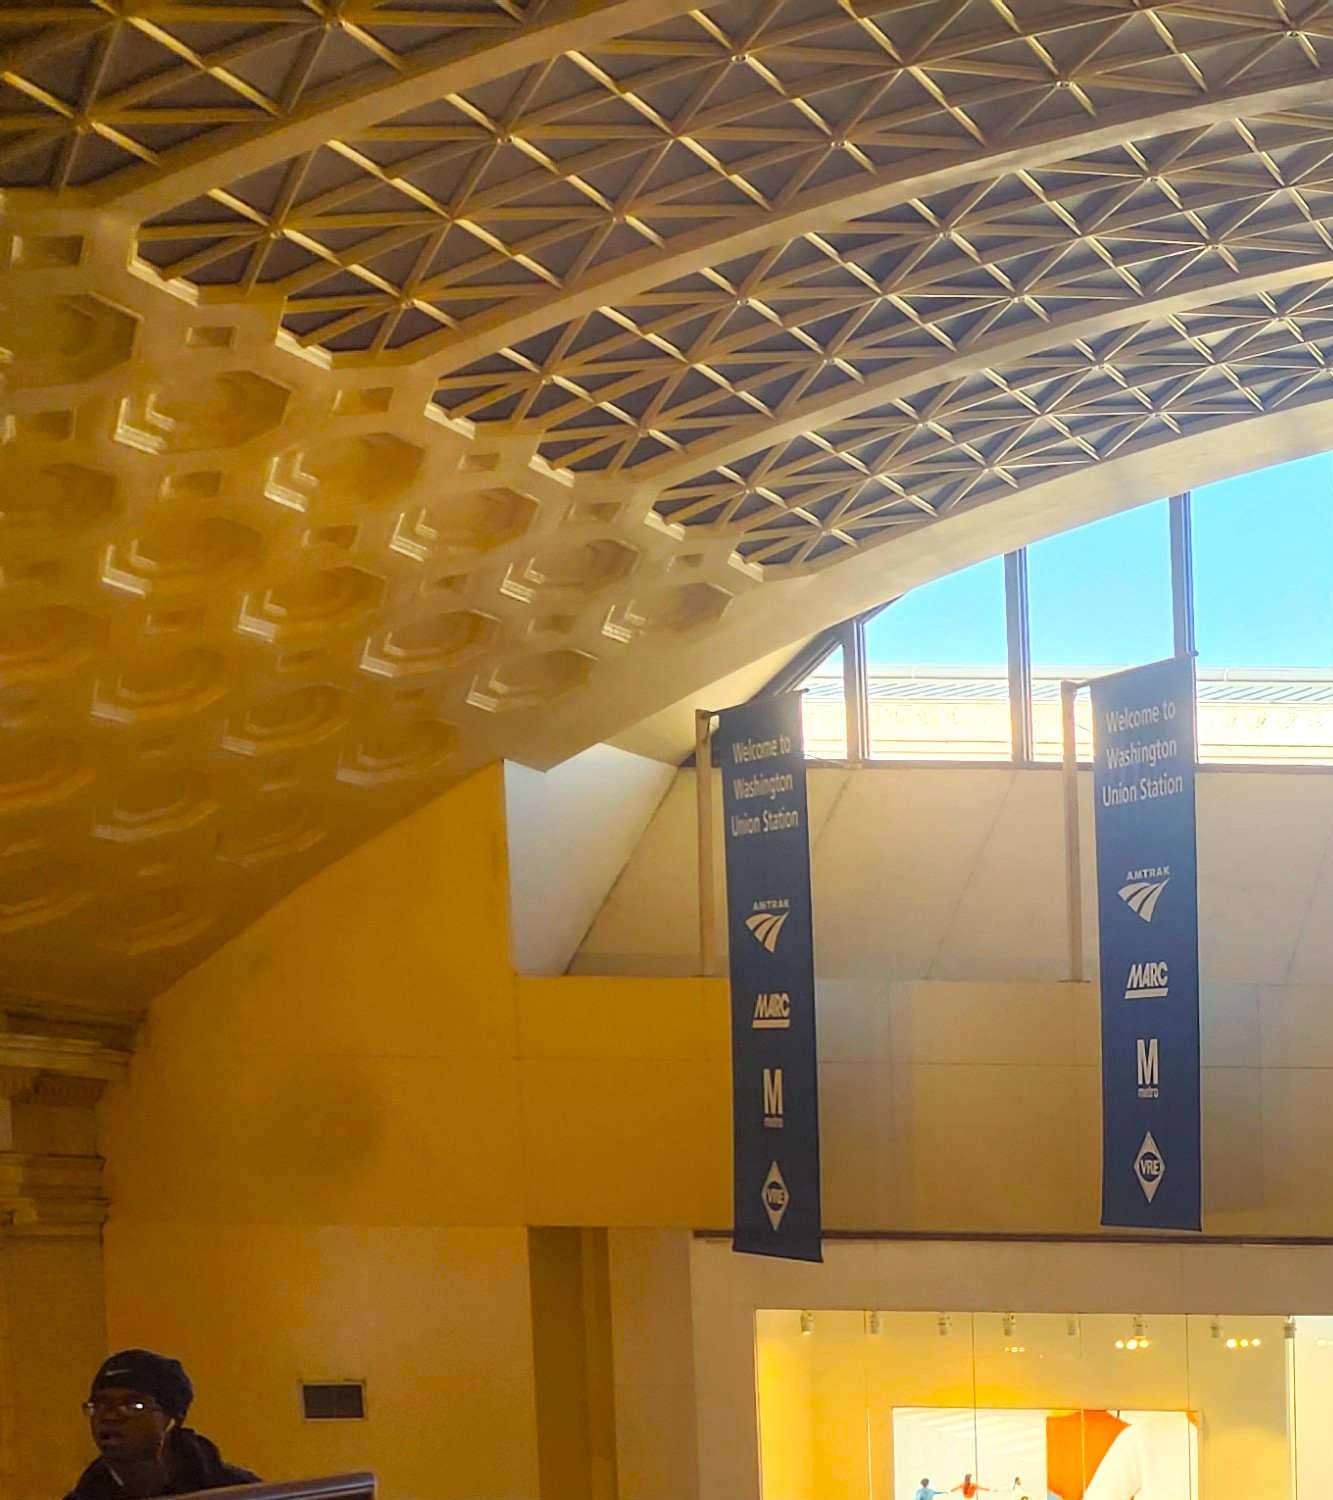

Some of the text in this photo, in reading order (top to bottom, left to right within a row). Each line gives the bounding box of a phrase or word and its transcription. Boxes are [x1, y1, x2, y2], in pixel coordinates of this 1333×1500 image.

[1106, 701, 1178, 734] Welcome to
[733, 734, 793, 763] Welcome to
[1106, 735, 1178, 772] Washington
[734, 773, 793, 801] Washington
[1103, 773, 1182, 806] Union Station
[732, 807, 798, 836] Union Station
[1126, 865, 1171, 882] AMTRAK
[752, 899, 790, 912] AMTRAK
[1128, 961, 1168, 989] MARC
[753, 993, 791, 1019] MARC
[1137, 1039, 1158, 1084] M
[1139, 1158, 1160, 1177] VRE
